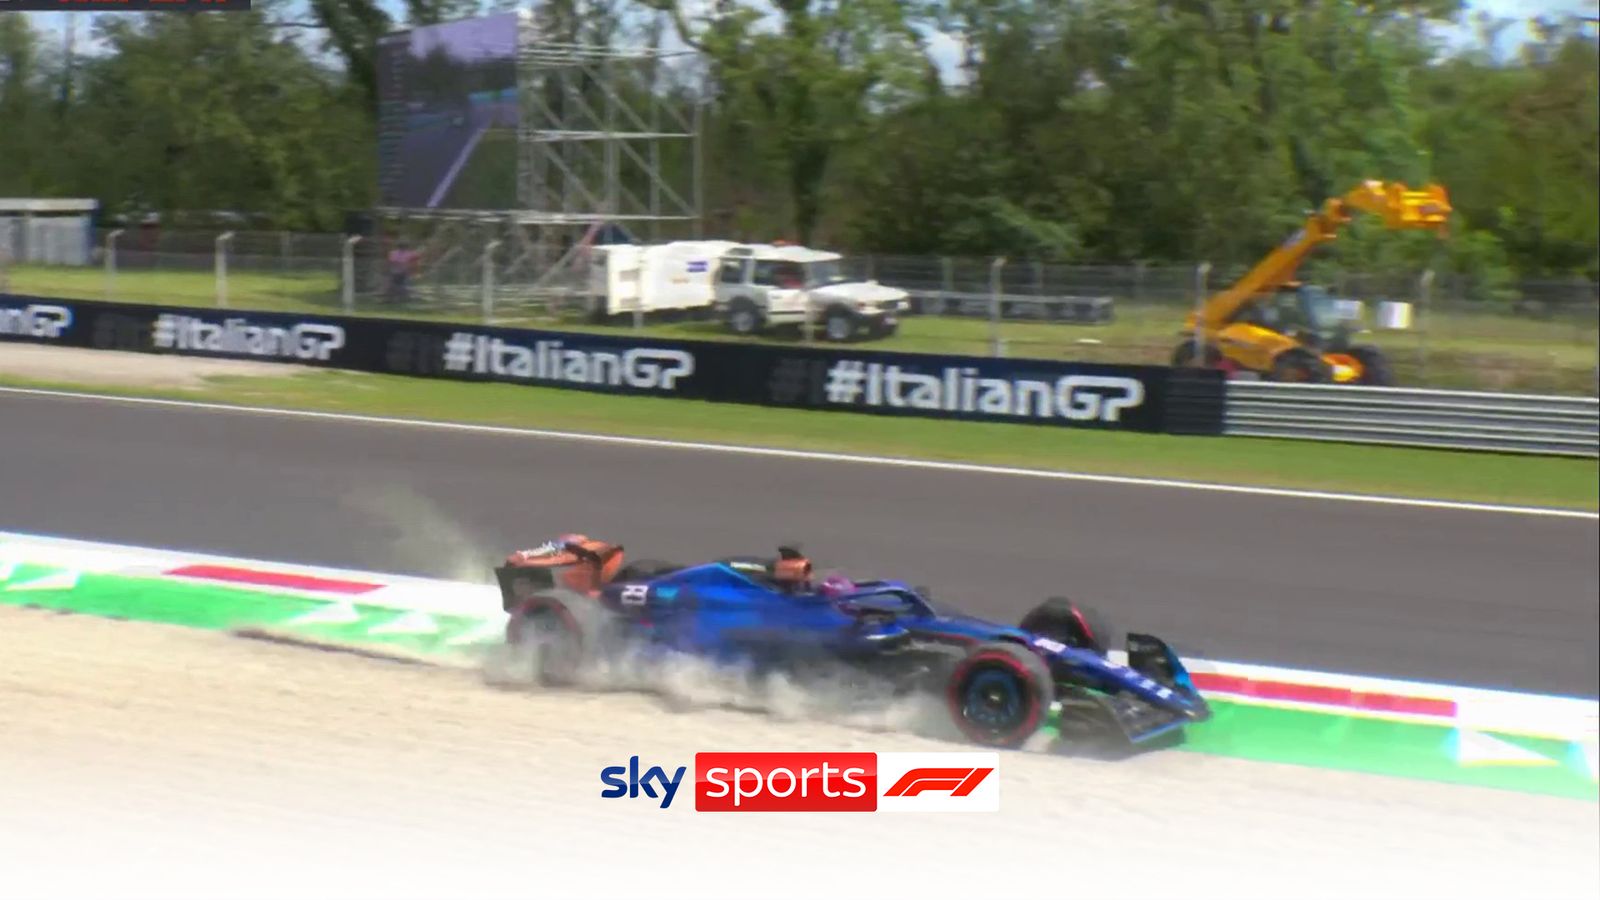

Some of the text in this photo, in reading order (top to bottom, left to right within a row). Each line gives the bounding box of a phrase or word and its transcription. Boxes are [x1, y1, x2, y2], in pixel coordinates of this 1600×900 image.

[152, 313, 345, 360] #ItalianGP
[443, 332, 694, 390] #ItalianGP
[825, 360, 1145, 421] #ItalianGP
